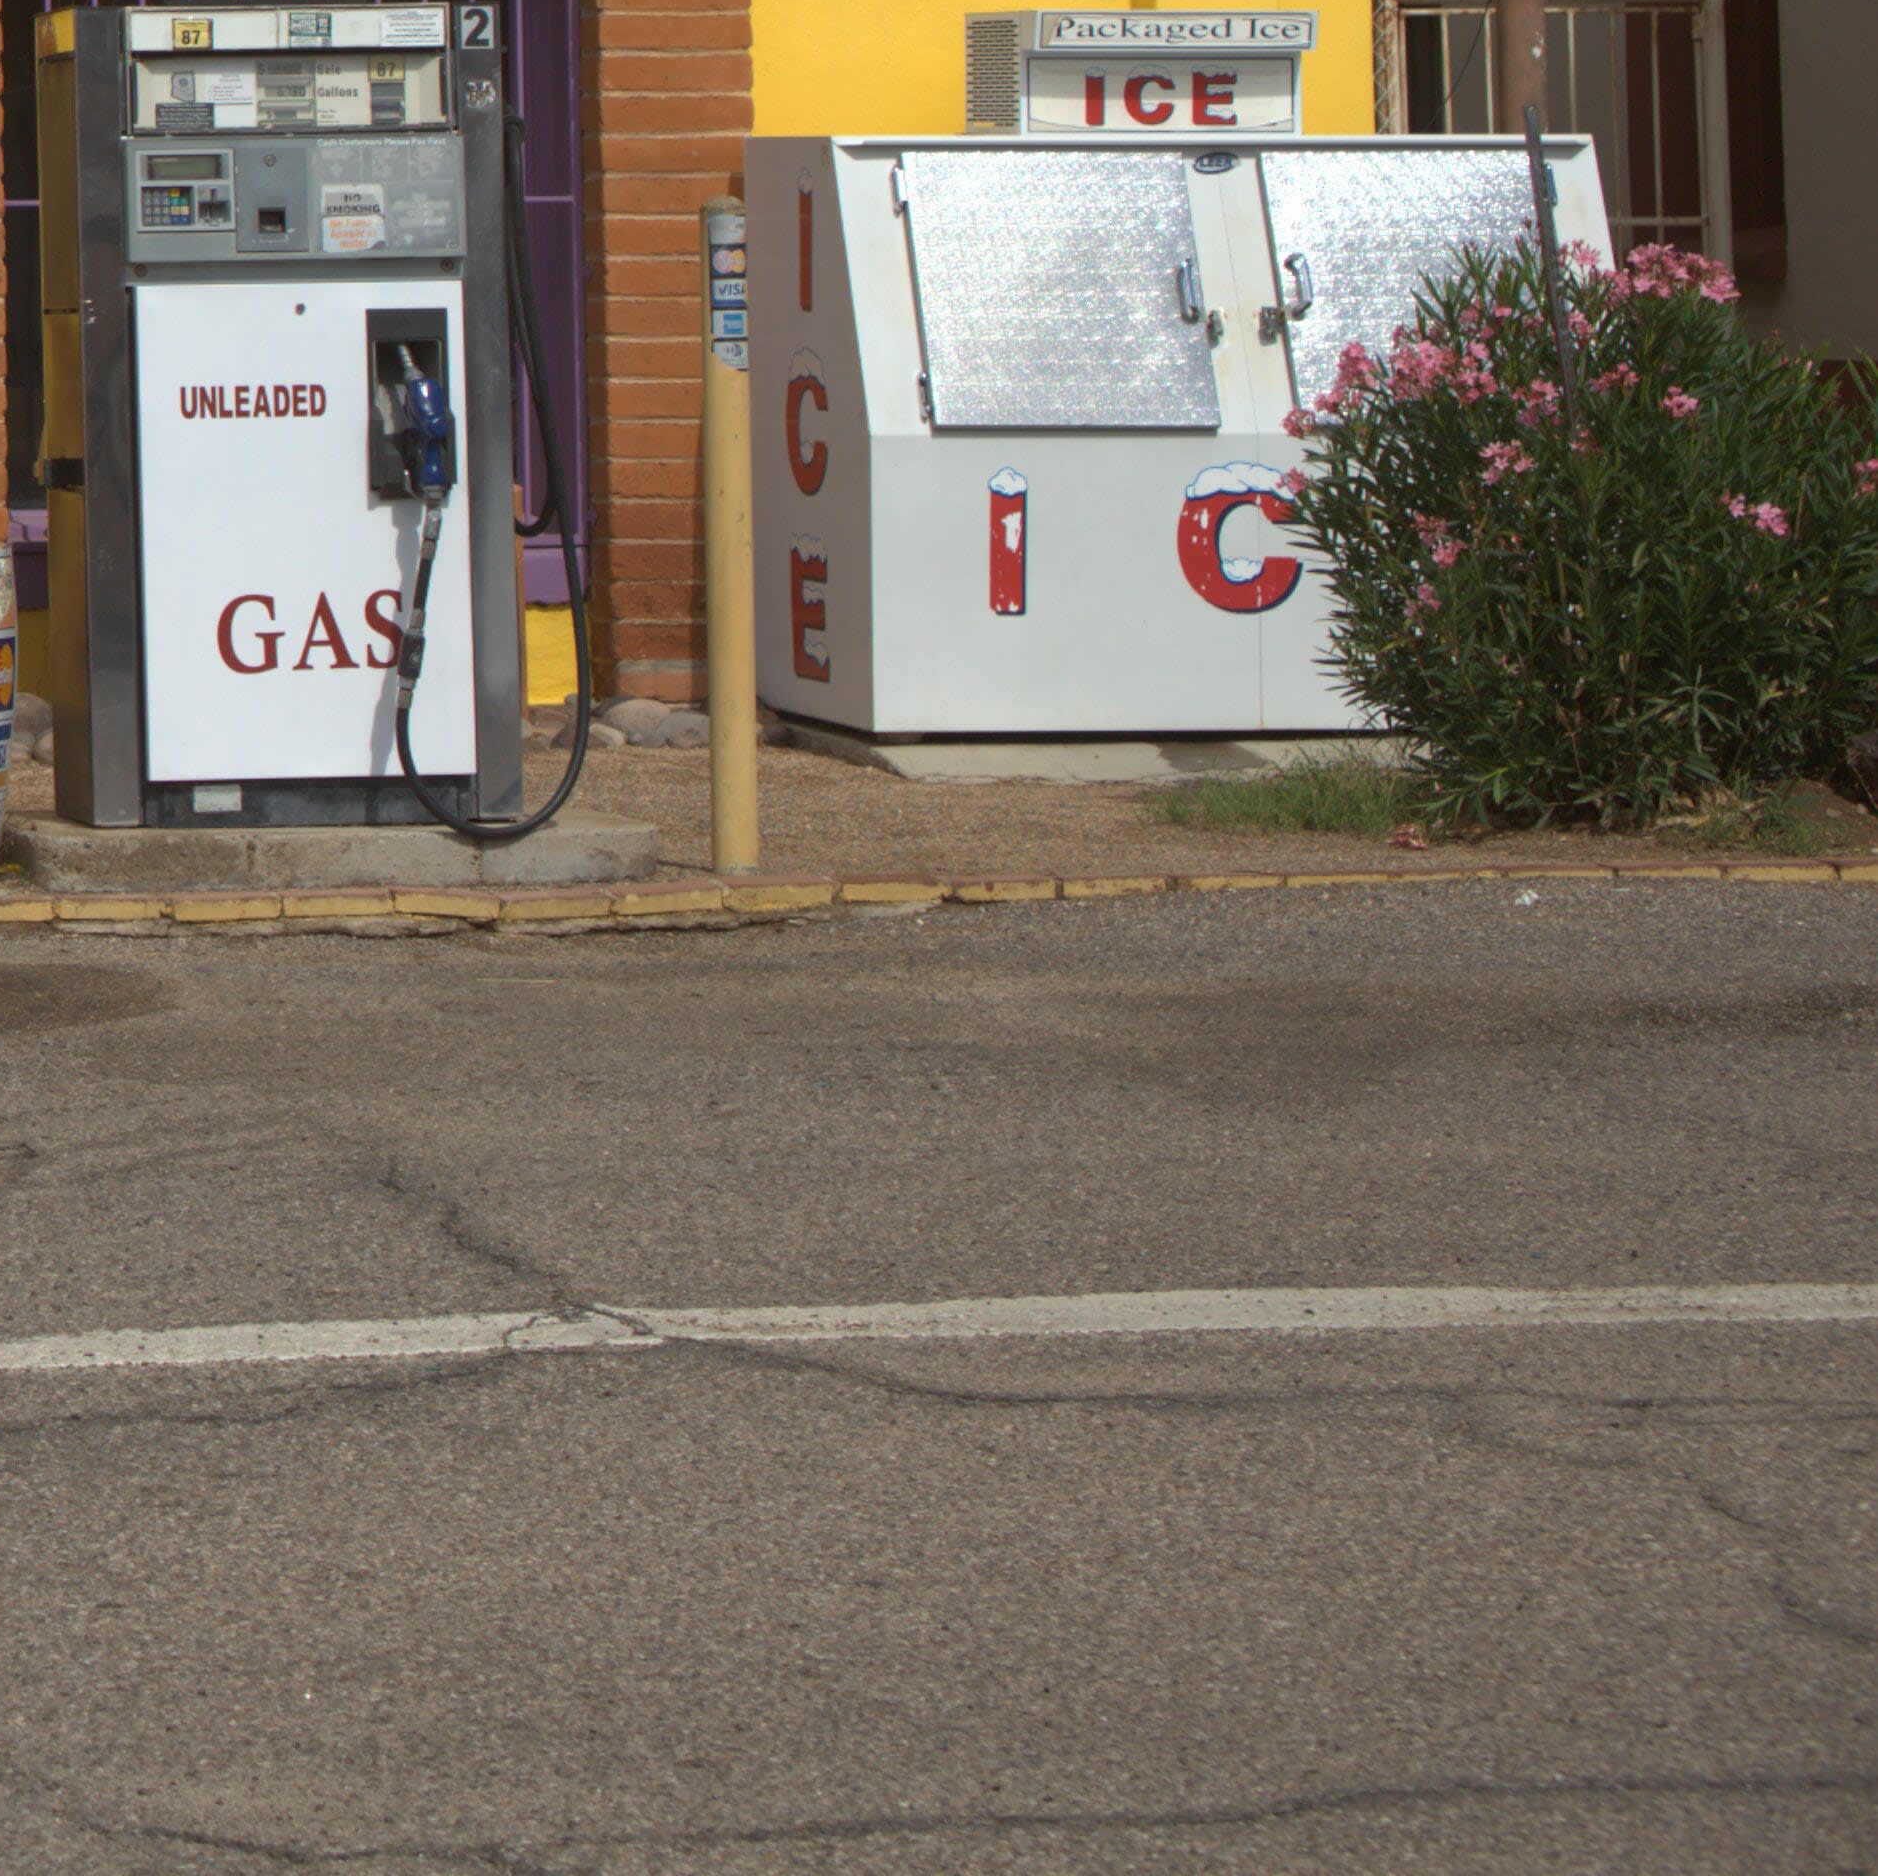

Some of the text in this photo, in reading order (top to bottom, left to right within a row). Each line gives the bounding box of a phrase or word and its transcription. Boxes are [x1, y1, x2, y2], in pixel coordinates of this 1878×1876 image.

[181, 29, 201, 45] 87
[462, 8, 490, 48] 2
[1055, 16, 1300, 43] Packaged Ice
[376, 63, 396, 78] 87
[317, 85, 358, 98] Gallons
[1084, 65, 1238, 126] ICE
[326, 204, 380, 213] SMOKING
[179, 384, 327, 420] UNLEADED
[786, 168, 832, 684] ICE
[215, 588, 411, 676] GAS
